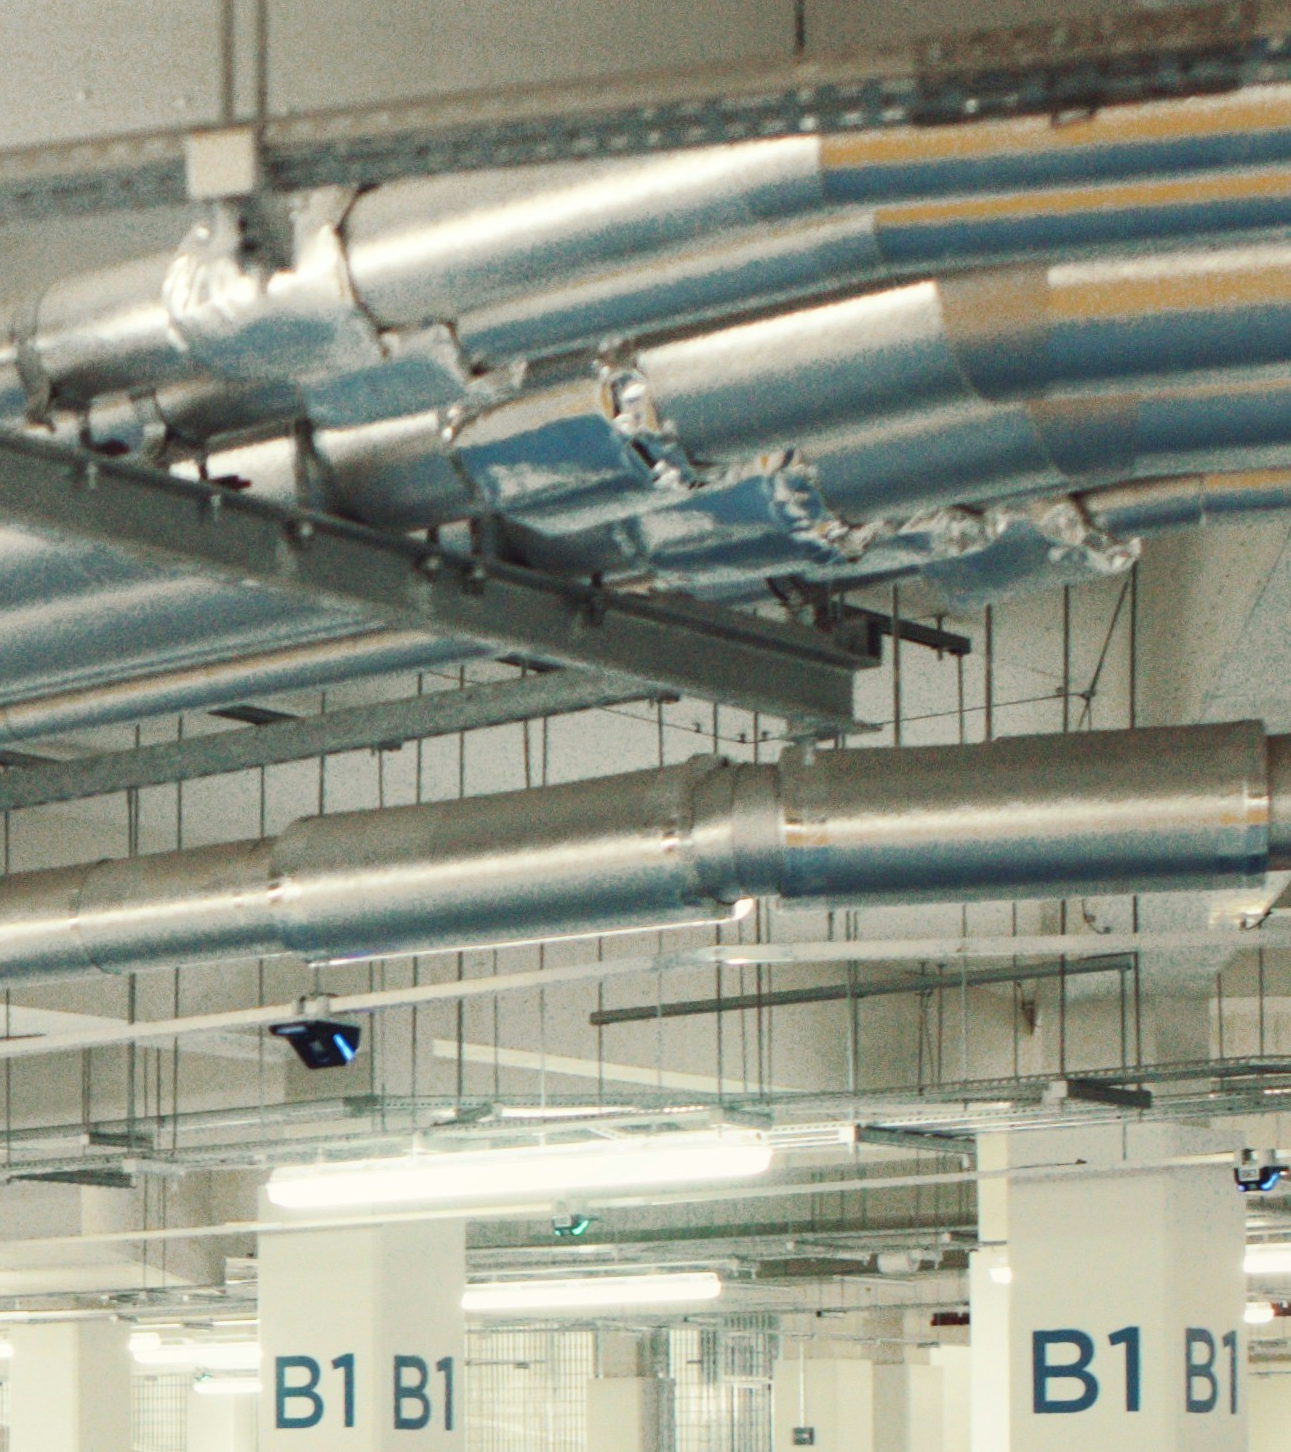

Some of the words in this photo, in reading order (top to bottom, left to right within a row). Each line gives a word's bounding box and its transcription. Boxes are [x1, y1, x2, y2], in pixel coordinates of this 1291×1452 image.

[275, 1352, 356, 1429] B1
[393, 1354, 454, 1431] B1
[1032, 1325, 1141, 1414] B1
[1185, 1327, 1238, 1415] B1
